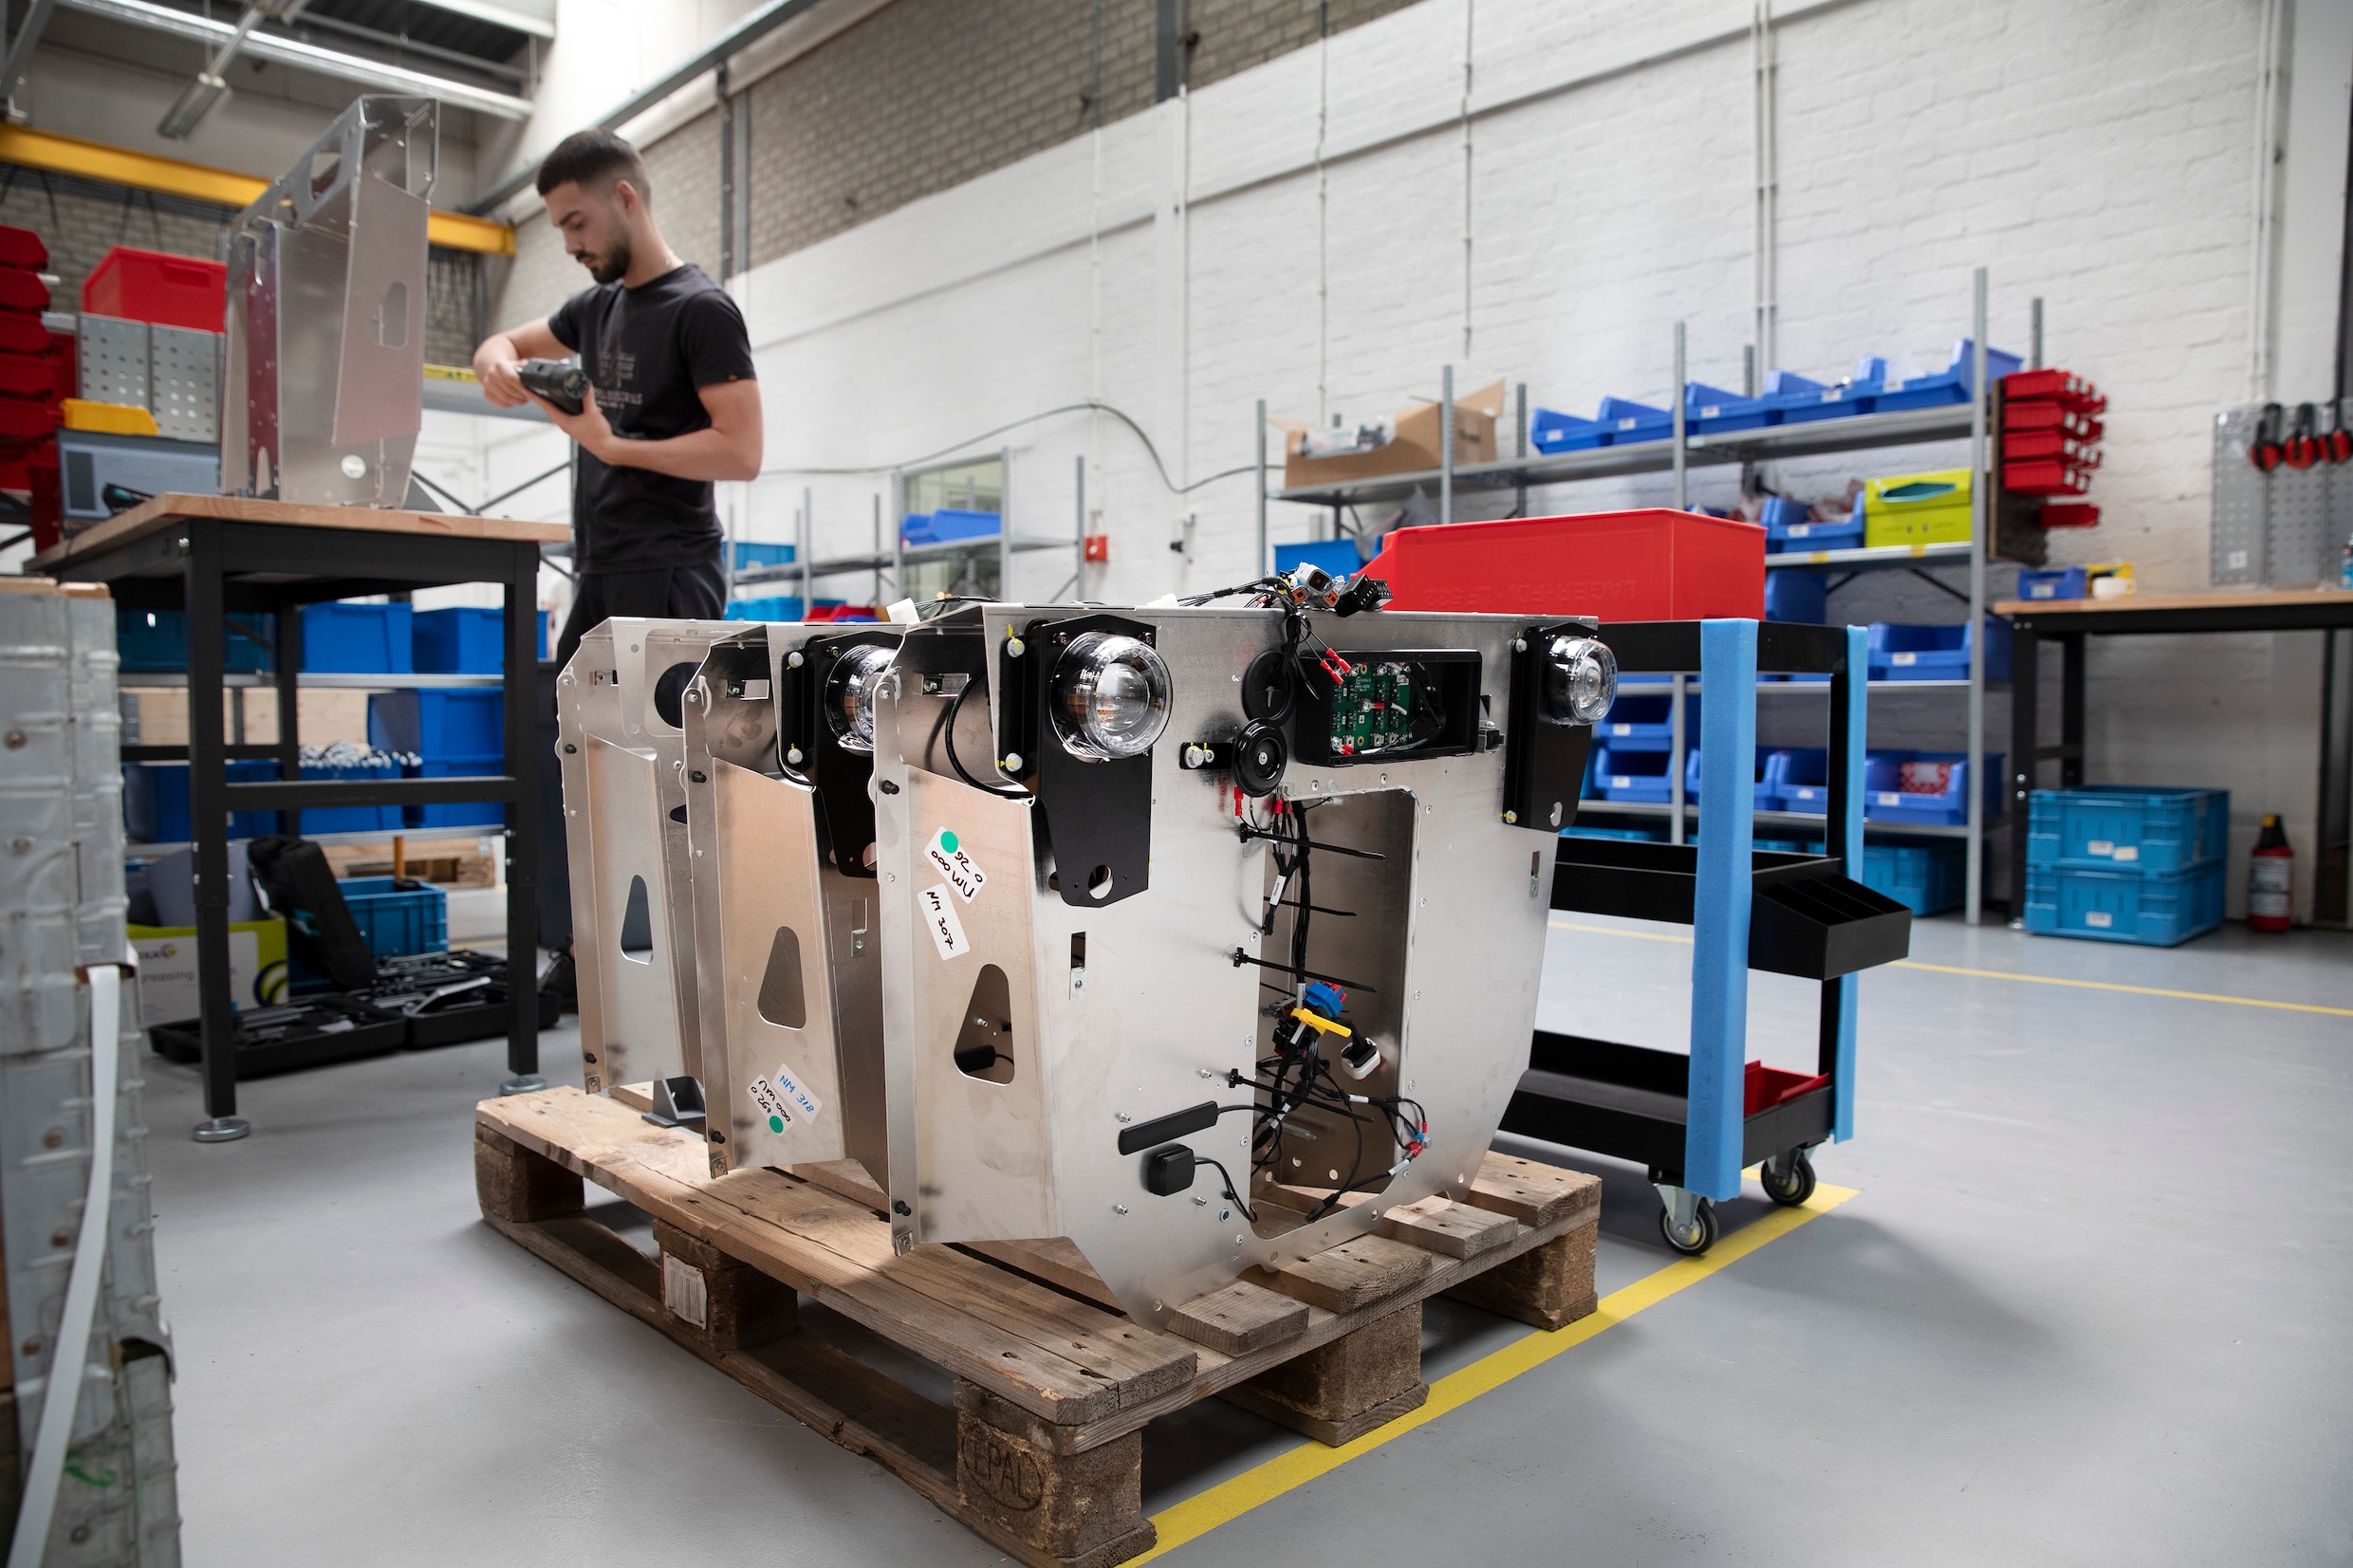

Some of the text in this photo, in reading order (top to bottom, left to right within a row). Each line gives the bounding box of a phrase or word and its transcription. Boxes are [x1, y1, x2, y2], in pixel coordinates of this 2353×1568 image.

[1467, 586, 1492, 606] LF
[1507, 579, 1637, 605] LAGER-FIX
[926, 891, 954, 950] NM 307
[779, 1075, 814, 1113] NM 318
[973, 1440, 1030, 1503] EPAL
